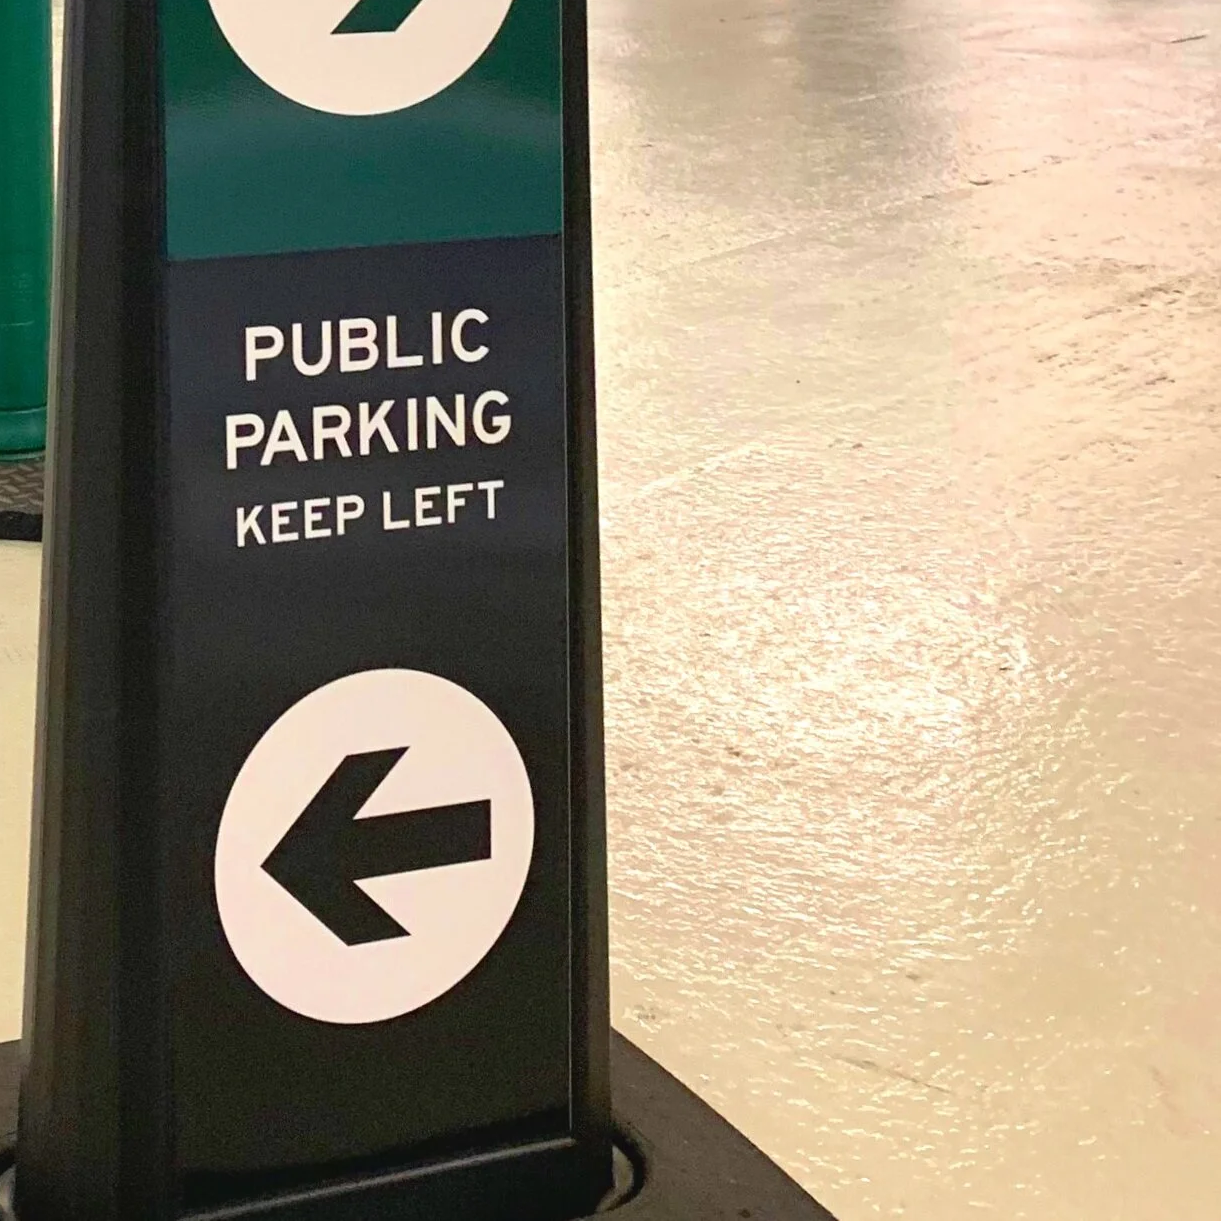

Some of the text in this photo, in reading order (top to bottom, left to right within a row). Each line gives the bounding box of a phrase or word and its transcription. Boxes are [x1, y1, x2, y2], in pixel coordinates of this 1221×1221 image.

[245, 308, 490, 381] PUBLIC
[225, 390, 512, 470] PARKING
[236, 480, 505, 548] KEEP LEFT
